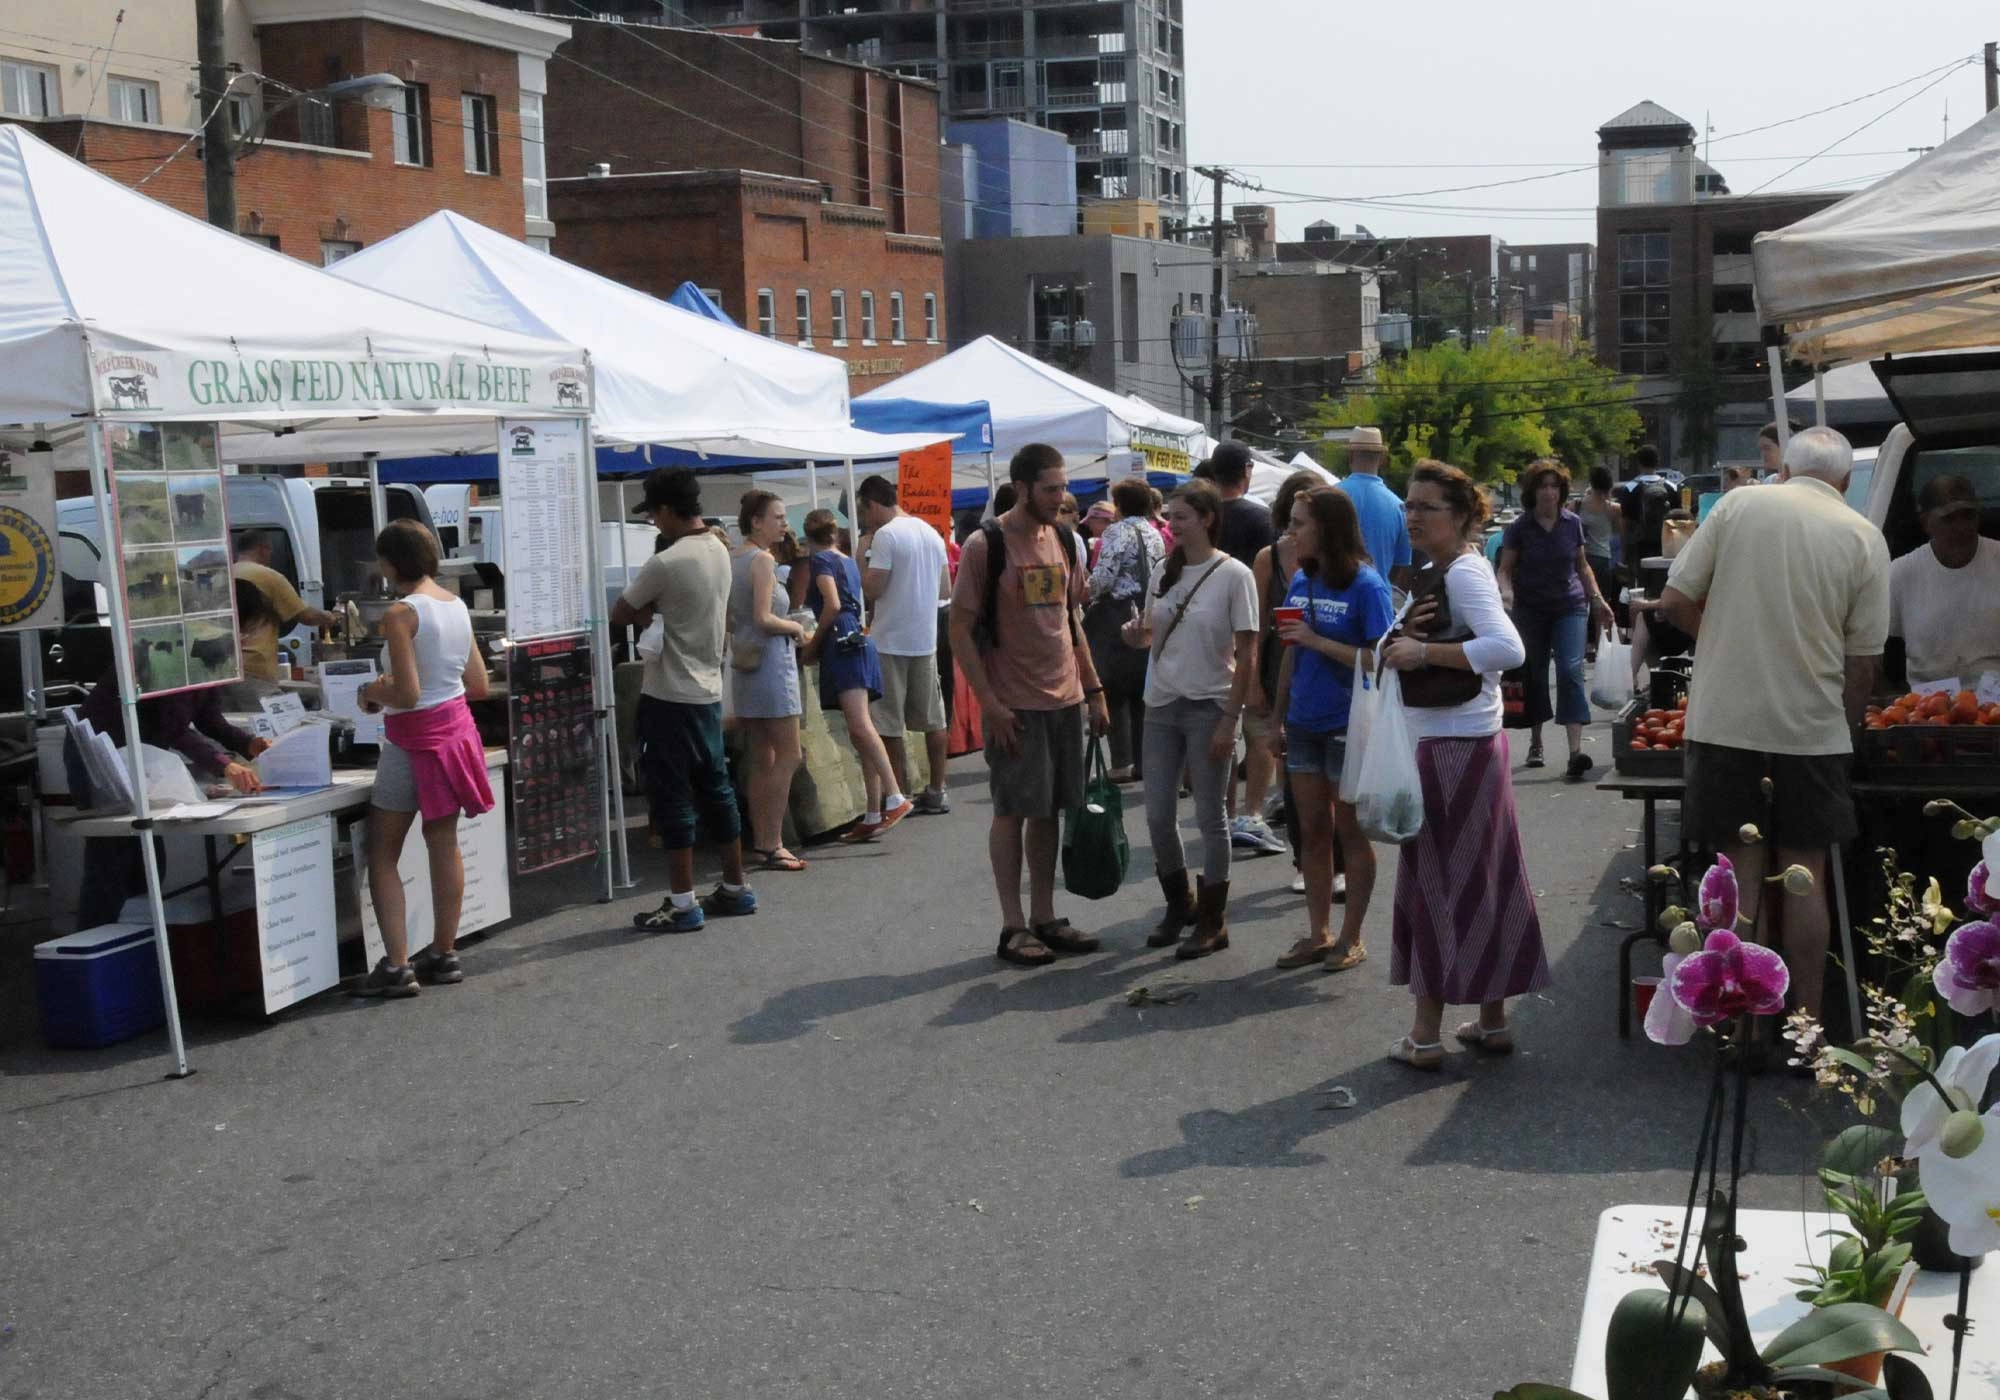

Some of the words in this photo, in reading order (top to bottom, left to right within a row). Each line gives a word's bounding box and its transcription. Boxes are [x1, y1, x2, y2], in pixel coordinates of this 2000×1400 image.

[188, 358, 283, 405] GRASS
[290, 360, 344, 402] FED
[348, 359, 471, 402] NATURAL
[475, 366, 532, 404] BEEF
[1156, 451, 1170, 469] FED
[1172, 454, 1188, 471] BEEF
[904, 465, 919, 479] The
